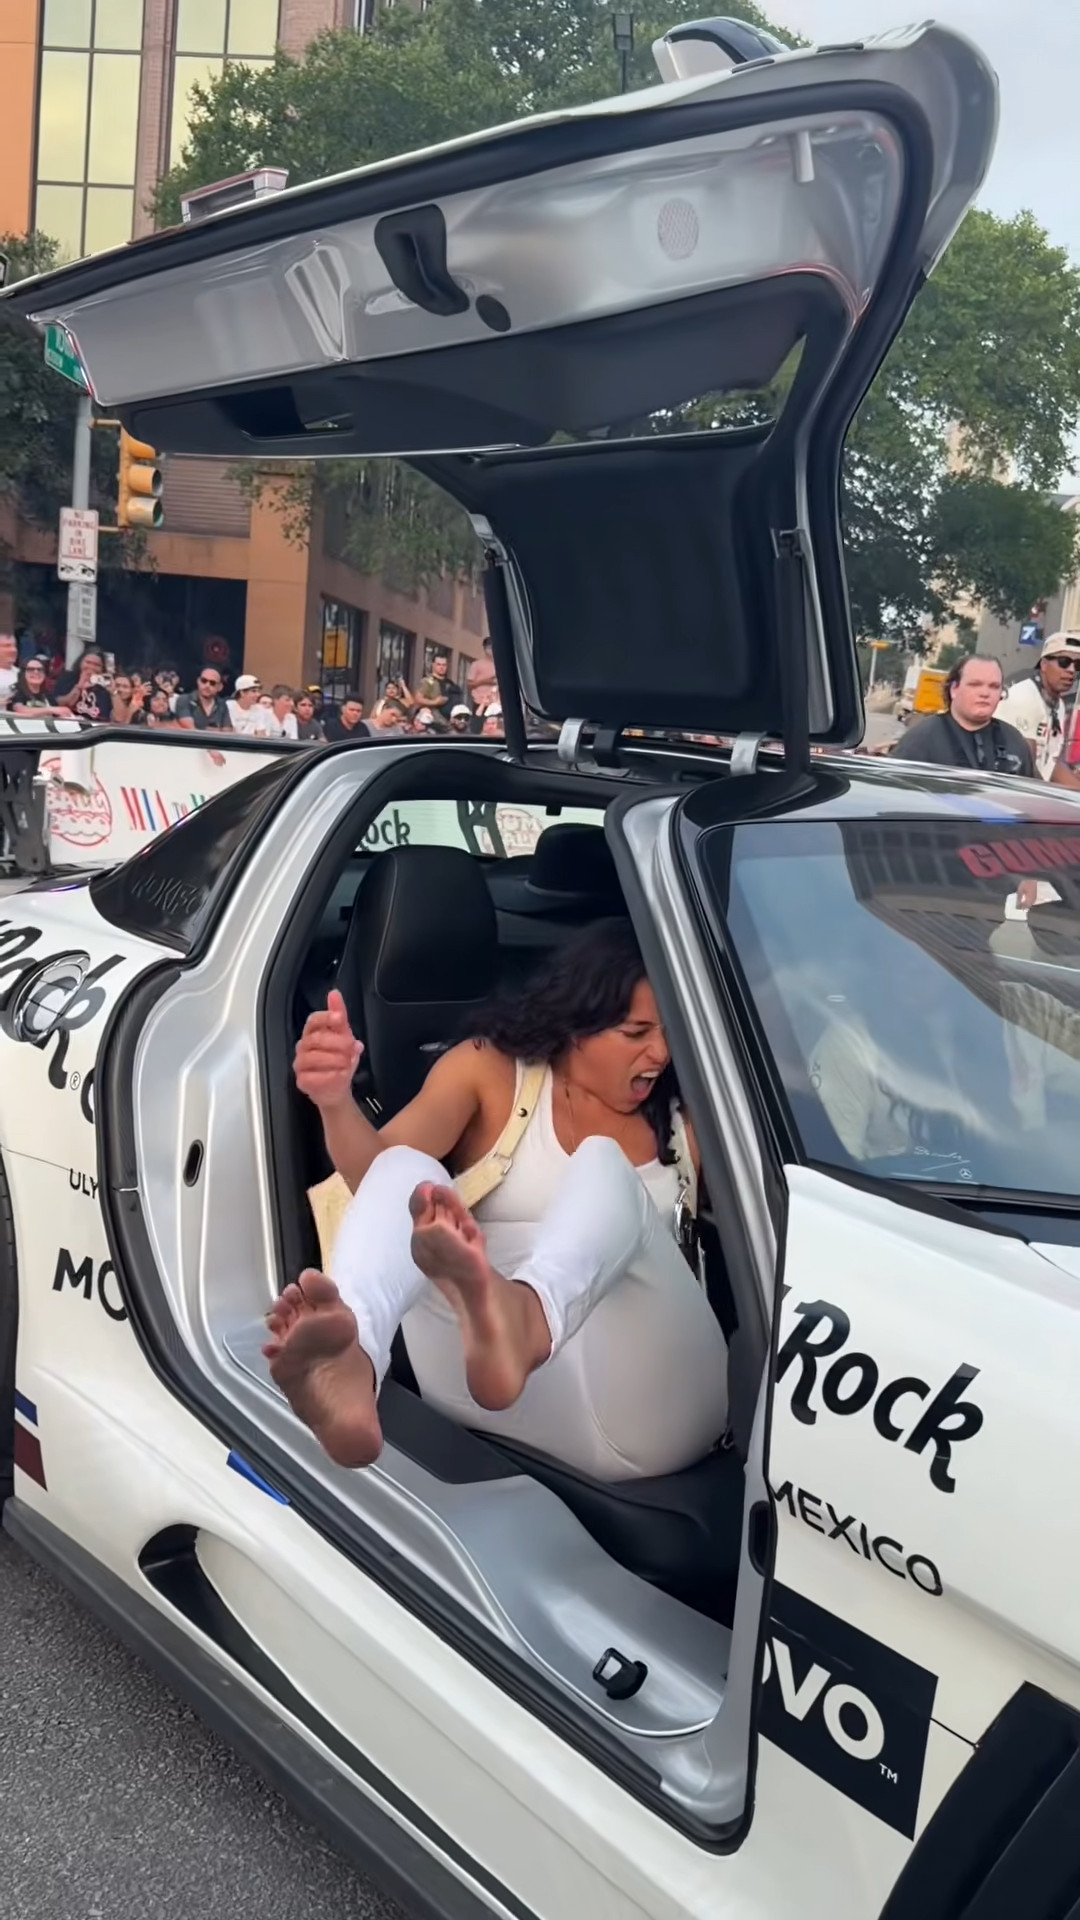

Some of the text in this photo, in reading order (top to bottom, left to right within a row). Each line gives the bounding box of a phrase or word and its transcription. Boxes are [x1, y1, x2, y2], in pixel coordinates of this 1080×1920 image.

[775, 1300, 984, 1493] Rock
[769, 1480, 943, 1597] MEXICO
[762, 1636, 885, 1760] VO
